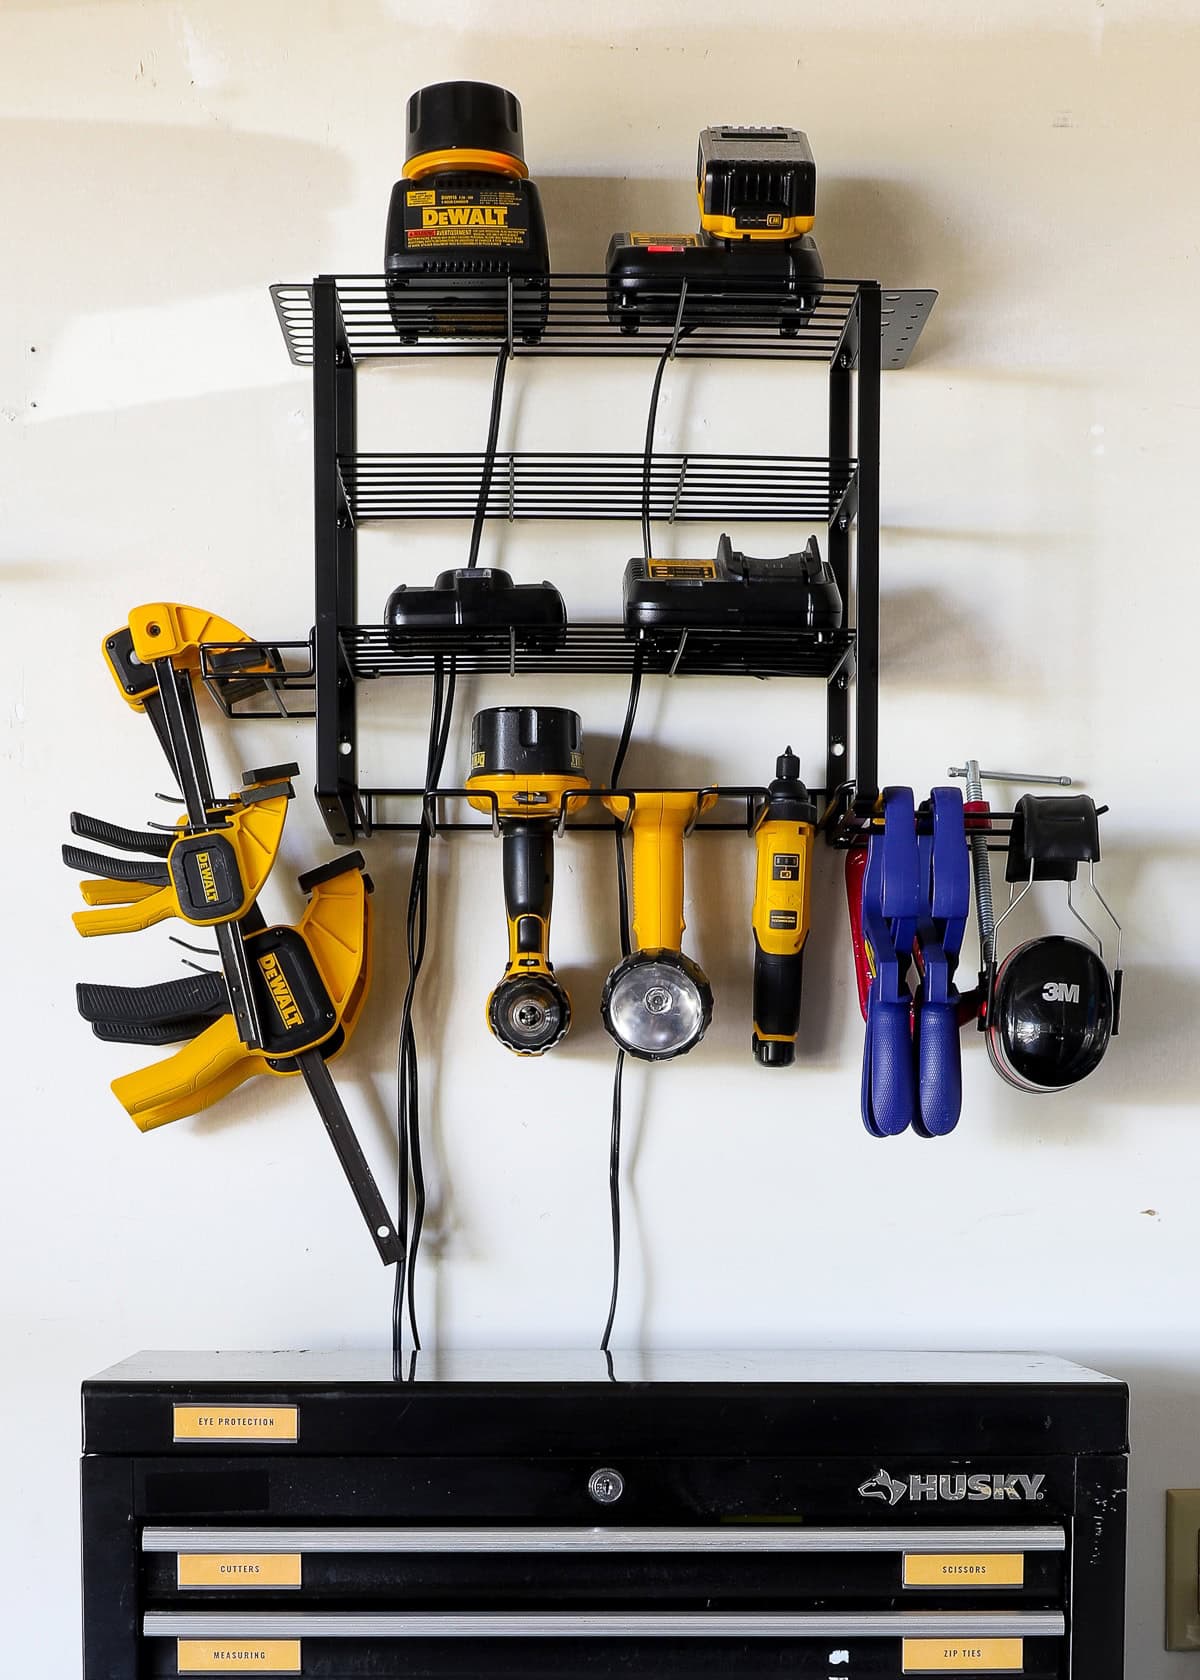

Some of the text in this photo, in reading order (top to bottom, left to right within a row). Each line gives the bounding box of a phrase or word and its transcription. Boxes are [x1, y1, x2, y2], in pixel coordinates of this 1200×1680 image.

[423, 208, 508, 226] DEWALT
[197, 852, 218, 902] DEWALT
[259, 952, 303, 1026] DEWALT
[1041, 982, 1080, 1003] 3M
[198, 1417, 275, 1427] EYE PROTECTION
[909, 1474, 1045, 1501] HUSKY
[220, 1565, 260, 1573] CUTTERS
[942, 1565, 986, 1574] SCISSORS
[213, 1651, 266, 1660] MEASURING
[943, 1649, 982, 1658] ZIP TIES
